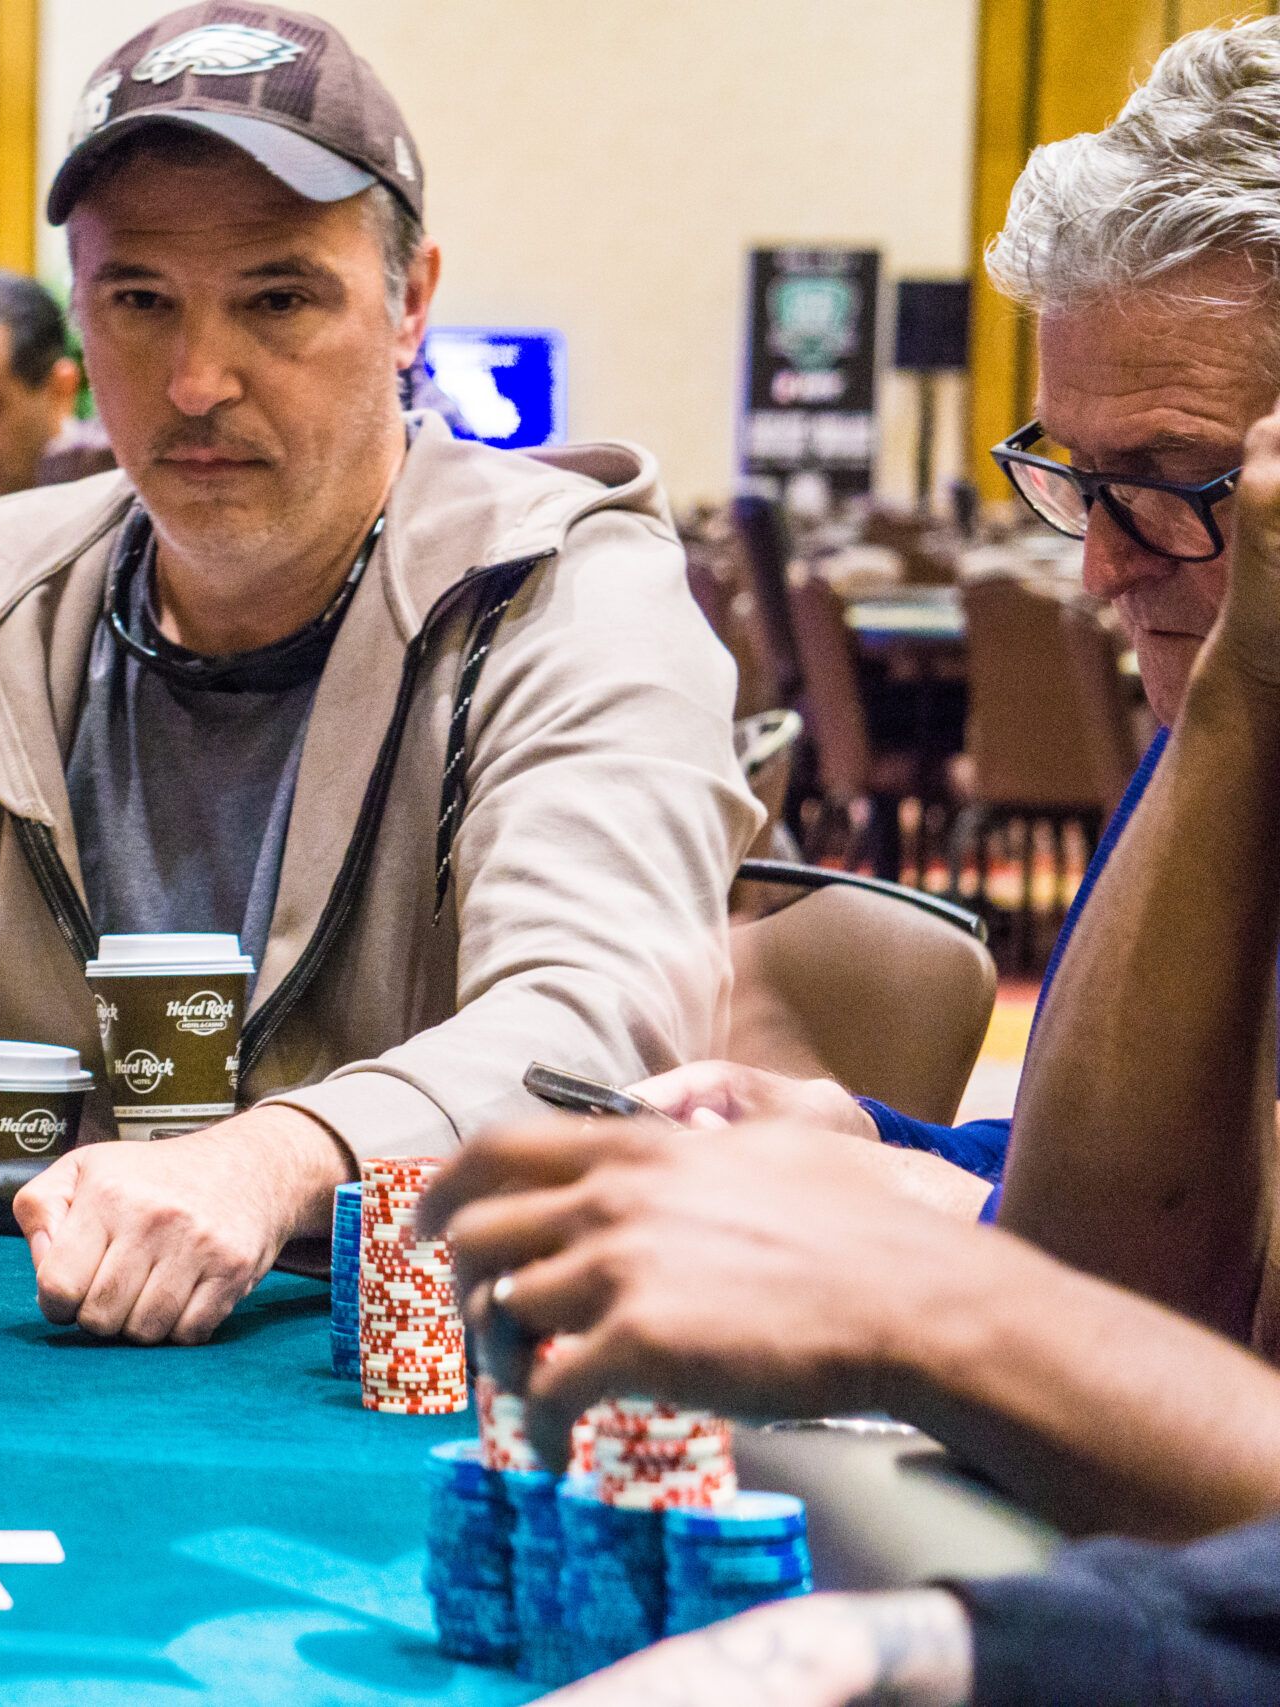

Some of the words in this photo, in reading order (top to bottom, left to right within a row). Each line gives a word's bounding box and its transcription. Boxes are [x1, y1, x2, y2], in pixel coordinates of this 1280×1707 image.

[166, 1000, 206, 1017] Hard
[205, 1000, 235, 1019] Rock
[114, 1059, 140, 1074] Hard
[140, 1057, 175, 1077] Rock
[0, 1117, 38, 1132] Hard
[37, 1118, 67, 1136] Rock
